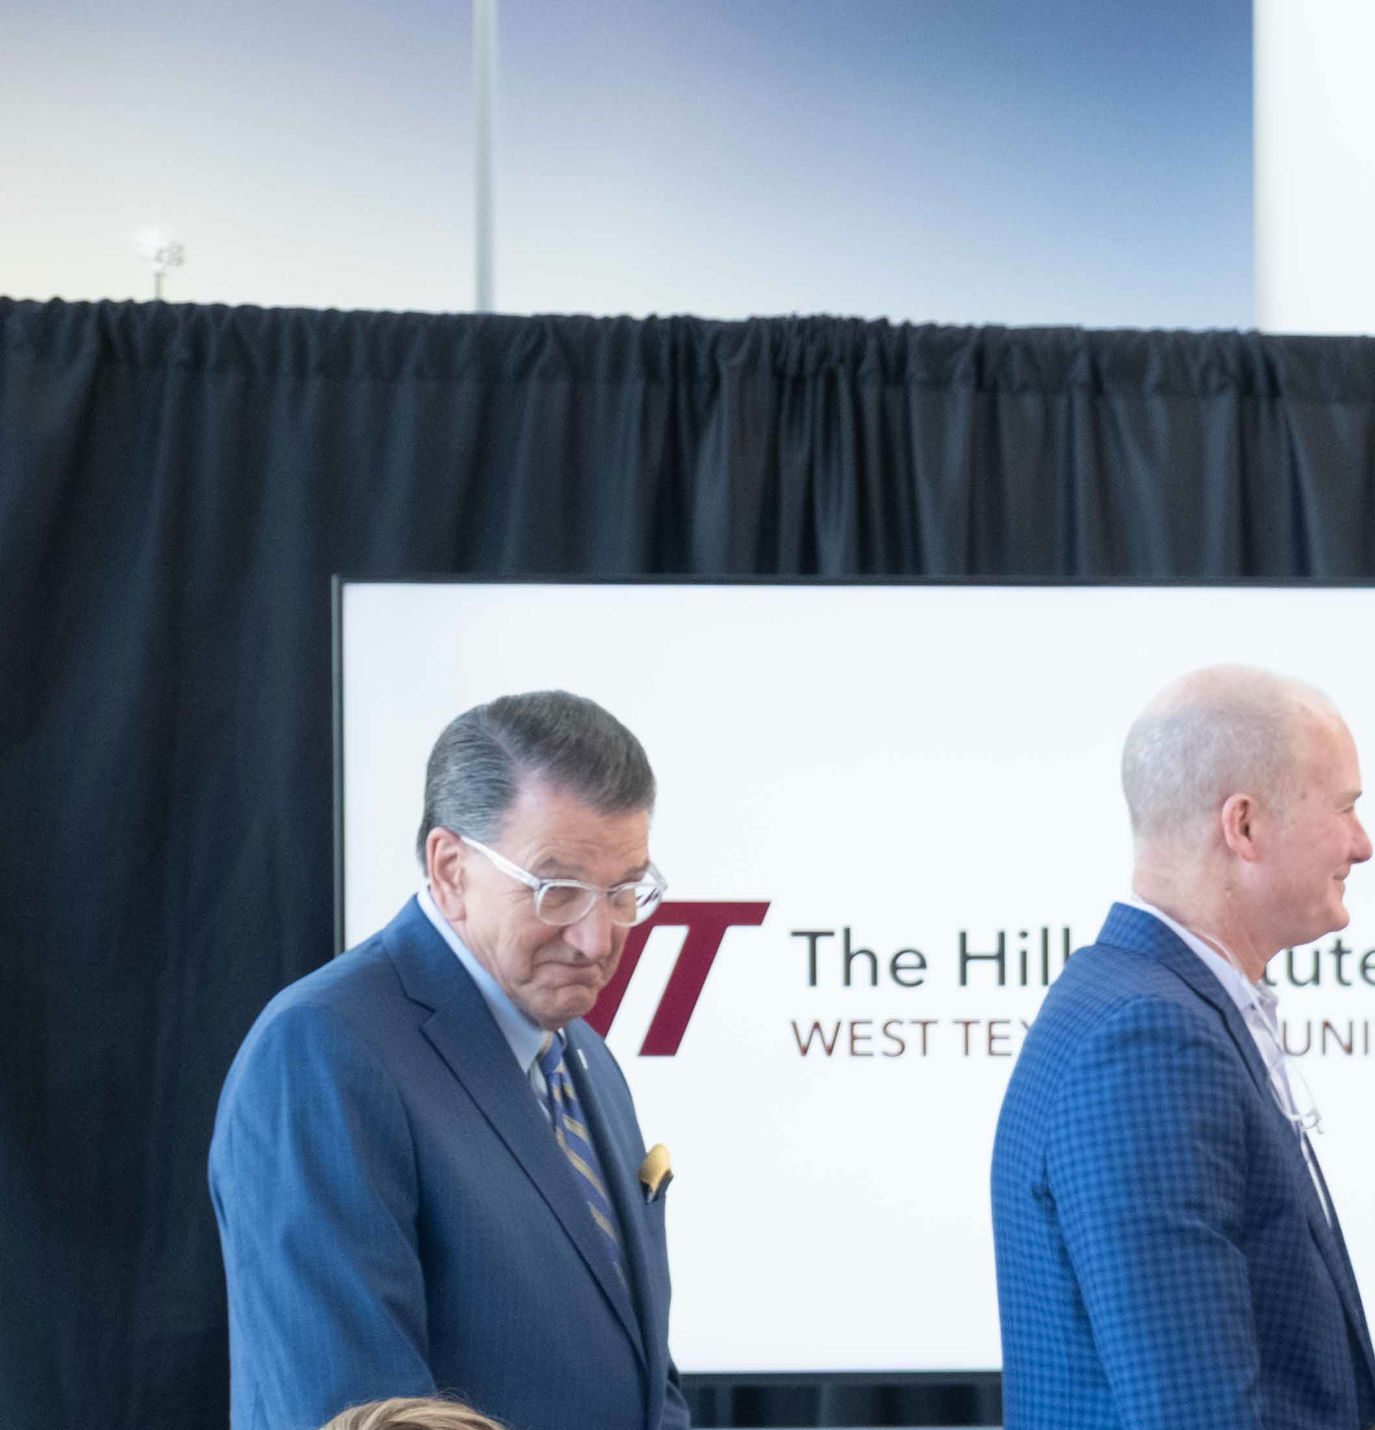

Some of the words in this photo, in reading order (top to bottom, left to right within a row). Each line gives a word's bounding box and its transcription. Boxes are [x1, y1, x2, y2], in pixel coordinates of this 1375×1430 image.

[790, 925, 928, 989] The
[957, 925, 1071, 988] Hill
[790, 1018, 939, 1058] WEST
[952, 1018, 1030, 1058] TE
